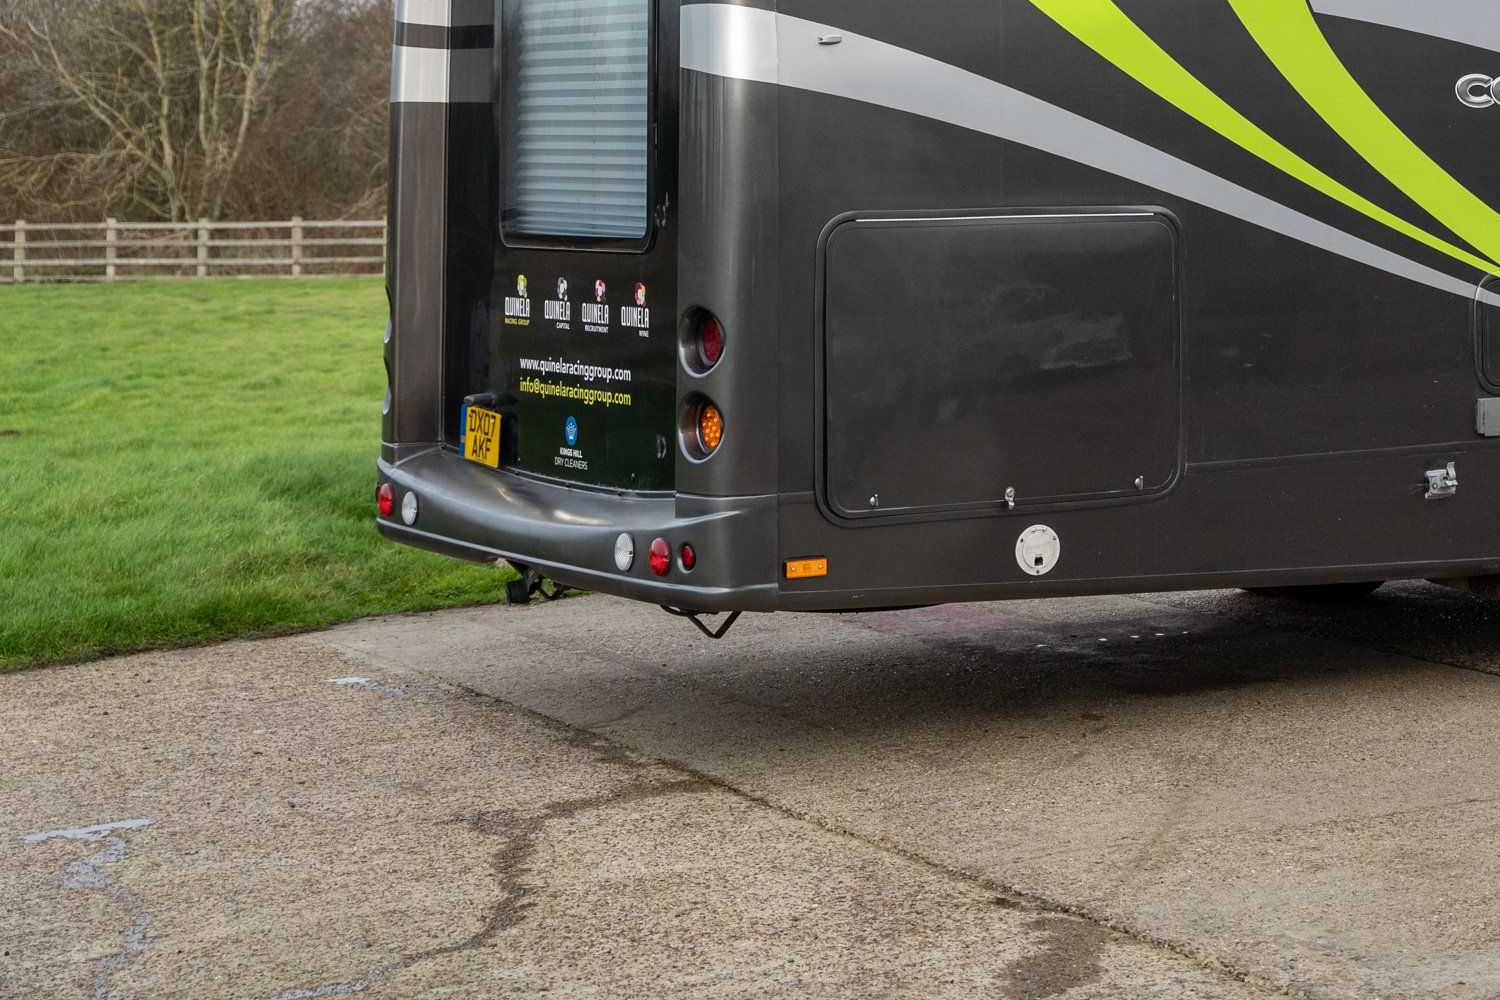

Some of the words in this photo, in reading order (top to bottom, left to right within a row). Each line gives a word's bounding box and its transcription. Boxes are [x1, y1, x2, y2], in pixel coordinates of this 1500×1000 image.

[504, 296, 530, 317] QUINELA
[544, 300, 570, 321] QUINELA
[582, 303, 609, 324] QUINELA
[621, 306, 649, 328] QUINELA
[504, 317, 517, 325] RACING
[556, 321, 570, 330] CAPITAL
[584, 324, 609, 333] RECRUITMENT
[638, 329, 649, 337] WINE
[520, 357, 631, 383] www.quinelaracinggroup.com
[520, 377, 631, 407] info@quinelaracinggroup.com
[469, 409, 496, 438] DX07
[472, 434, 491, 460] AKF
[559, 447, 573, 456] KINGS
[573, 448, 583, 458] HILL
[554, 456, 564, 466] DRY
[564, 458, 588, 470] CLEANERS
